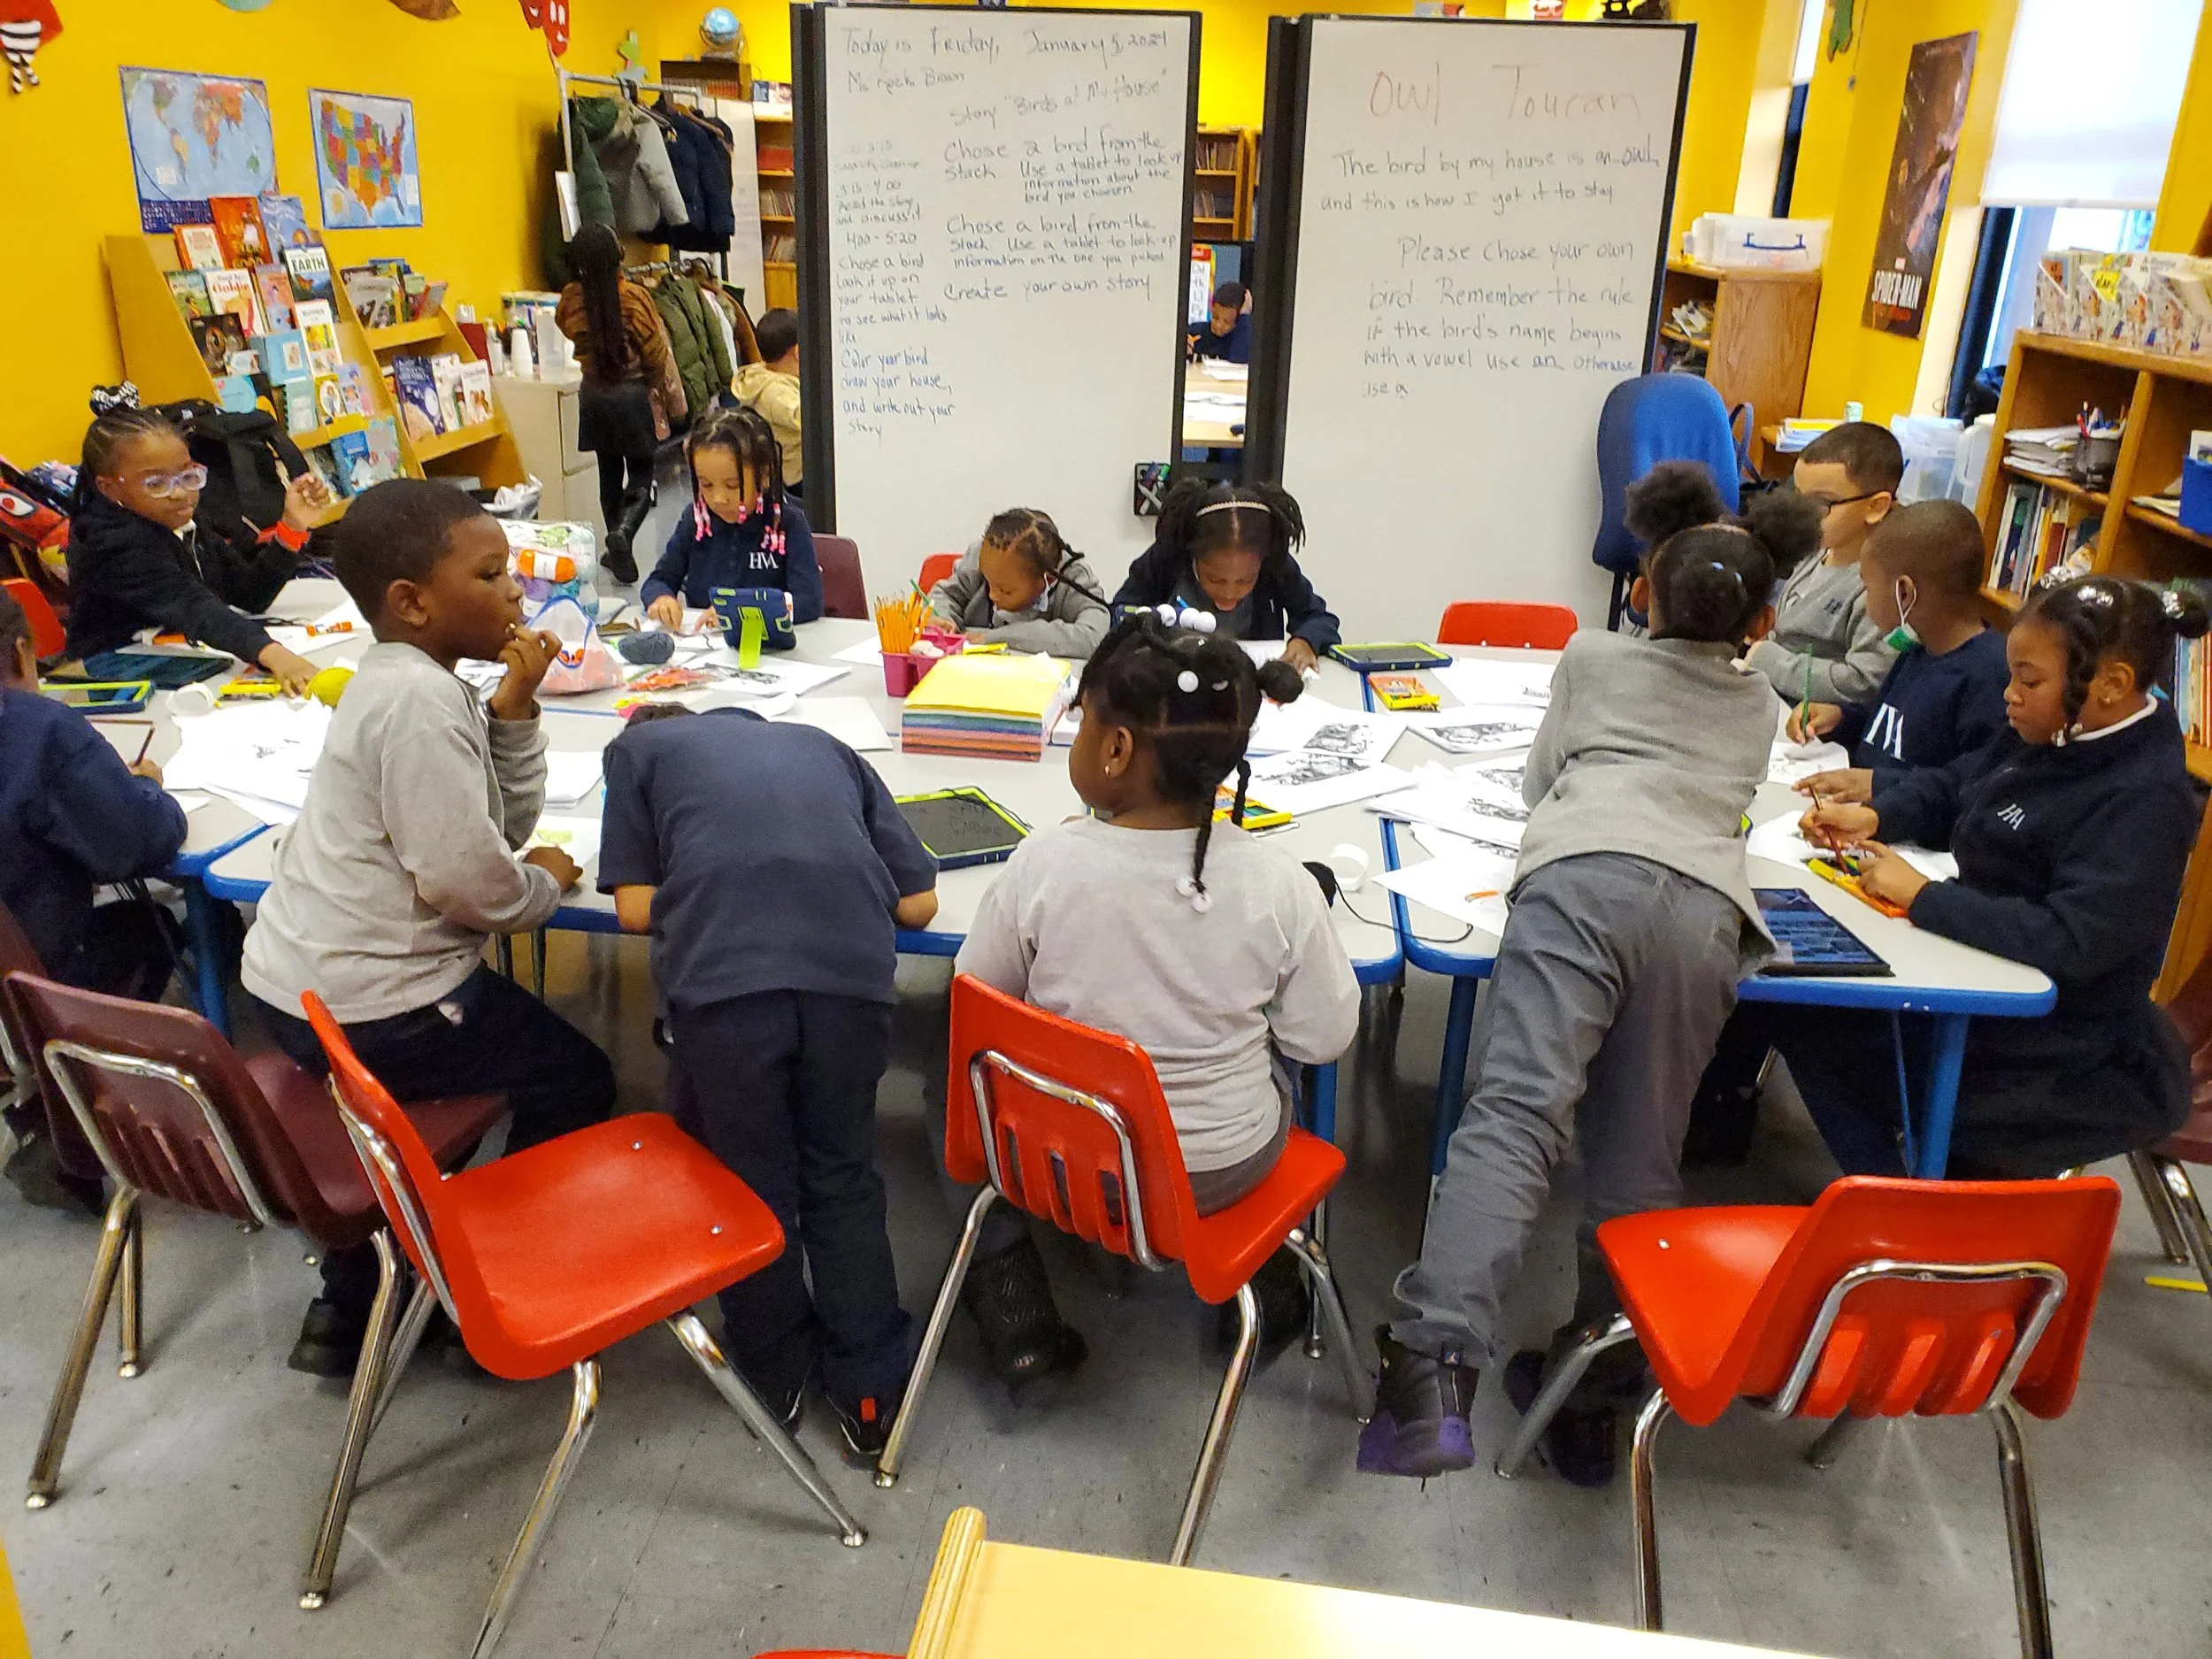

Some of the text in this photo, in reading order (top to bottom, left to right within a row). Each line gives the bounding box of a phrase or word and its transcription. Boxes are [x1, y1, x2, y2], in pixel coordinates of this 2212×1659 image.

[841, 27, 888, 69] Today
[895, 39, 913, 52] is
[930, 25, 1000, 66] Friday,
[1022, 24, 1108, 71] January
[1370, 62, 1640, 126] Owl Toucan
[944, 122, 1166, 163] Chose a bird from the
[1020, 160, 1047, 180] Use
[1056, 161, 1065, 175] a
[1072, 155, 1108, 173] tablet
[1114, 151, 1130, 168] to
[1138, 151, 1163, 166] look
[1169, 149, 1183, 166] up
[1106, 168, 1140, 184] about
[1147, 167, 1170, 180] the
[1333, 149, 1379, 177] The
[1386, 146, 1425, 174] bird
[1440, 151, 1461, 180] by
[1469, 156, 1494, 180] my
[1505, 150, 1555, 169] house
[1566, 152, 1584, 166] is
[1595, 150, 1619, 166] an
[1025, 190, 1049, 204] bird
[1057, 189, 1077, 206] you
[1321, 180, 1614, 217] and this is how I got it to stay
[947, 211, 1156, 235] Chose a bird from the
[1007, 236, 1036, 252] Use
[1043, 237, 1056, 251] a
[1064, 234, 1100, 249] tablet
[1106, 234, 1125, 249] to
[1130, 232, 1156, 248] look
[1160, 234, 1177, 250] up
[1398, 234, 1471, 269] Please
[1549, 242, 1590, 270] your
[1596, 240, 1633, 262] own
[291, 256, 326, 272] EARTH
[884, 256, 895, 269] a
[899, 251, 925, 269] bird
[953, 252, 1025, 269] information
[1030, 255, 1045, 265] on
[1073, 252, 1094, 264] one
[1102, 252, 1122, 270] you
[867, 273, 874, 288] it
[881, 275, 896, 292] up
[902, 273, 920, 285] on
[943, 276, 1009, 302] Create
[1022, 280, 1059, 303] your
[1061, 279, 1099, 293] own
[1369, 276, 1633, 311] bird Remember the rule
[1871, 269, 1923, 311] SPIDER-MAN
[838, 287, 919, 312] your tablet
[856, 312, 879, 326] see
[880, 307, 907, 323] what
[907, 305, 919, 322] it
[1394, 317, 1432, 338] the
[1441, 313, 1499, 340] bird's
[1509, 326, 1557, 346] name
[1570, 317, 1622, 349] begins
[878, 350, 902, 374] your
[902, 343, 929, 367] bird
[1363, 349, 1399, 369] with
[1405, 354, 1416, 367] a
[1423, 349, 1473, 370] vowel
[1486, 354, 1522, 371] use
[841, 370, 953, 397] draw your house,
[842, 396, 867, 415] and
[903, 396, 926, 417] out
[928, 403, 956, 426] your
[749, 551, 779, 569] HVA
[1997, 803, 2026, 831] HVA
